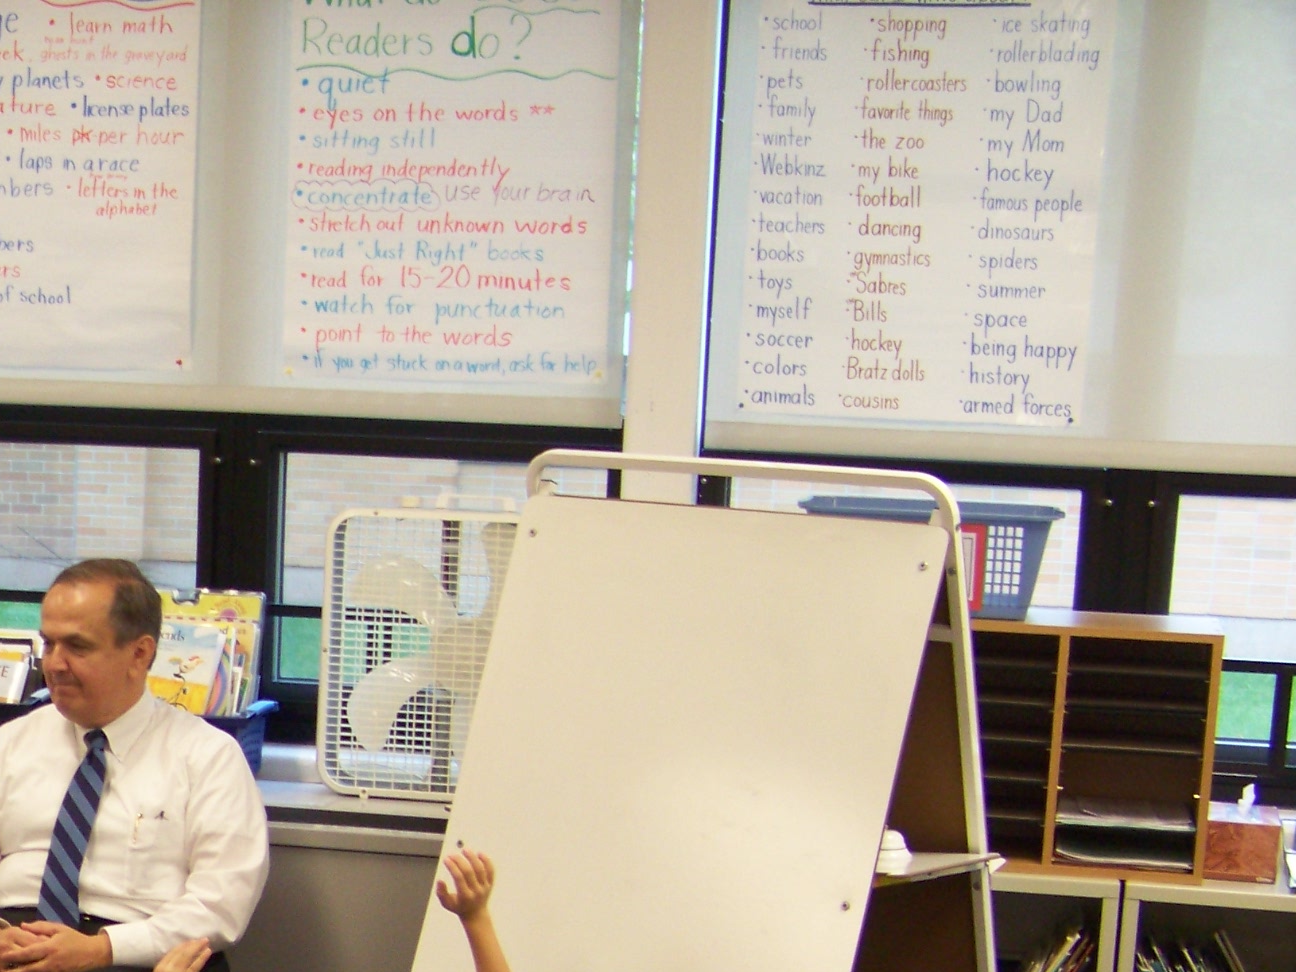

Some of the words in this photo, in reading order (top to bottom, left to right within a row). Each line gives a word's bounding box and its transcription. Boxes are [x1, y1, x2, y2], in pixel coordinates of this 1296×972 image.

[69, 12, 112, 33] learn
[122, 15, 173, 33] math
[773, 10, 822, 31] school
[877, 10, 947, 42] shopping
[1031, 12, 1091, 39] skating
[303, 17, 433, 58] Readers
[774, 34, 827, 61] friends
[870, 40, 930, 66] fishing
[12, 68, 84, 95] planets
[106, 74, 176, 91] science
[318, 67, 391, 109] quiet
[767, 73, 803, 99] pets
[994, 70, 1061, 99] bowling
[138, 97, 190, 122] plates
[313, 108, 363, 129] eyes
[407, 102, 445, 122] the
[456, 101, 518, 122] words
[768, 100, 816, 125] family
[859, 98, 911, 121] favorite
[918, 97, 953, 127] things
[1026, 100, 1063, 123] Dad
[20, 122, 61, 142] miles
[136, 125, 184, 145] hour
[313, 129, 380, 155] sitting
[390, 128, 435, 148] still
[763, 127, 812, 147] winter
[860, 129, 886, 149] the
[895, 136, 924, 150] zoo
[1021, 132, 1065, 152] Mom
[19, 148, 52, 173] laps
[308, 159, 373, 184] reading
[382, 157, 510, 188] independently
[760, 155, 826, 178] Webkinz
[888, 156, 919, 179] bike
[987, 160, 1054, 190] hockey
[308, 184, 432, 206] concentrate
[536, 181, 595, 203] brain
[759, 189, 823, 206] vacation
[854, 186, 922, 208] football
[980, 191, 1028, 210] famous
[1034, 192, 1083, 222] people
[417, 212, 503, 234] unknown
[515, 216, 587, 235] words
[758, 216, 825, 235] teachers
[858, 215, 922, 241] dancing
[977, 216, 1054, 241] dinosaurs
[313, 242, 345, 259] read
[488, 241, 544, 262] books
[757, 238, 804, 263] books
[854, 246, 931, 274] gymnastics
[979, 249, 1038, 278] spiders
[311, 271, 347, 288] read
[361, 266, 383, 287] for
[477, 269, 571, 291] minutes
[758, 273, 793, 298] toys
[856, 271, 906, 296] Sabres
[19, 285, 71, 304] school
[977, 285, 1046, 298] summer
[315, 293, 374, 314] watch
[386, 295, 414, 316] for
[435, 298, 565, 324] punctuation
[757, 298, 813, 327] myself
[854, 300, 887, 323] Bills
[315, 324, 362, 352] point
[400, 322, 432, 343] the
[443, 325, 513, 347] words
[974, 311, 1027, 339] space
[756, 333, 813, 349] soccer
[850, 328, 902, 356] hockey
[970, 338, 1016, 363] being
[1023, 334, 1078, 371] happy
[753, 356, 807, 375] colors
[846, 357, 888, 381] Bratz
[891, 359, 925, 382] dolls
[970, 366, 1030, 394] history
[752, 385, 815, 406] animals
[843, 395, 900, 410] cousins
[964, 399, 1014, 415] armed
